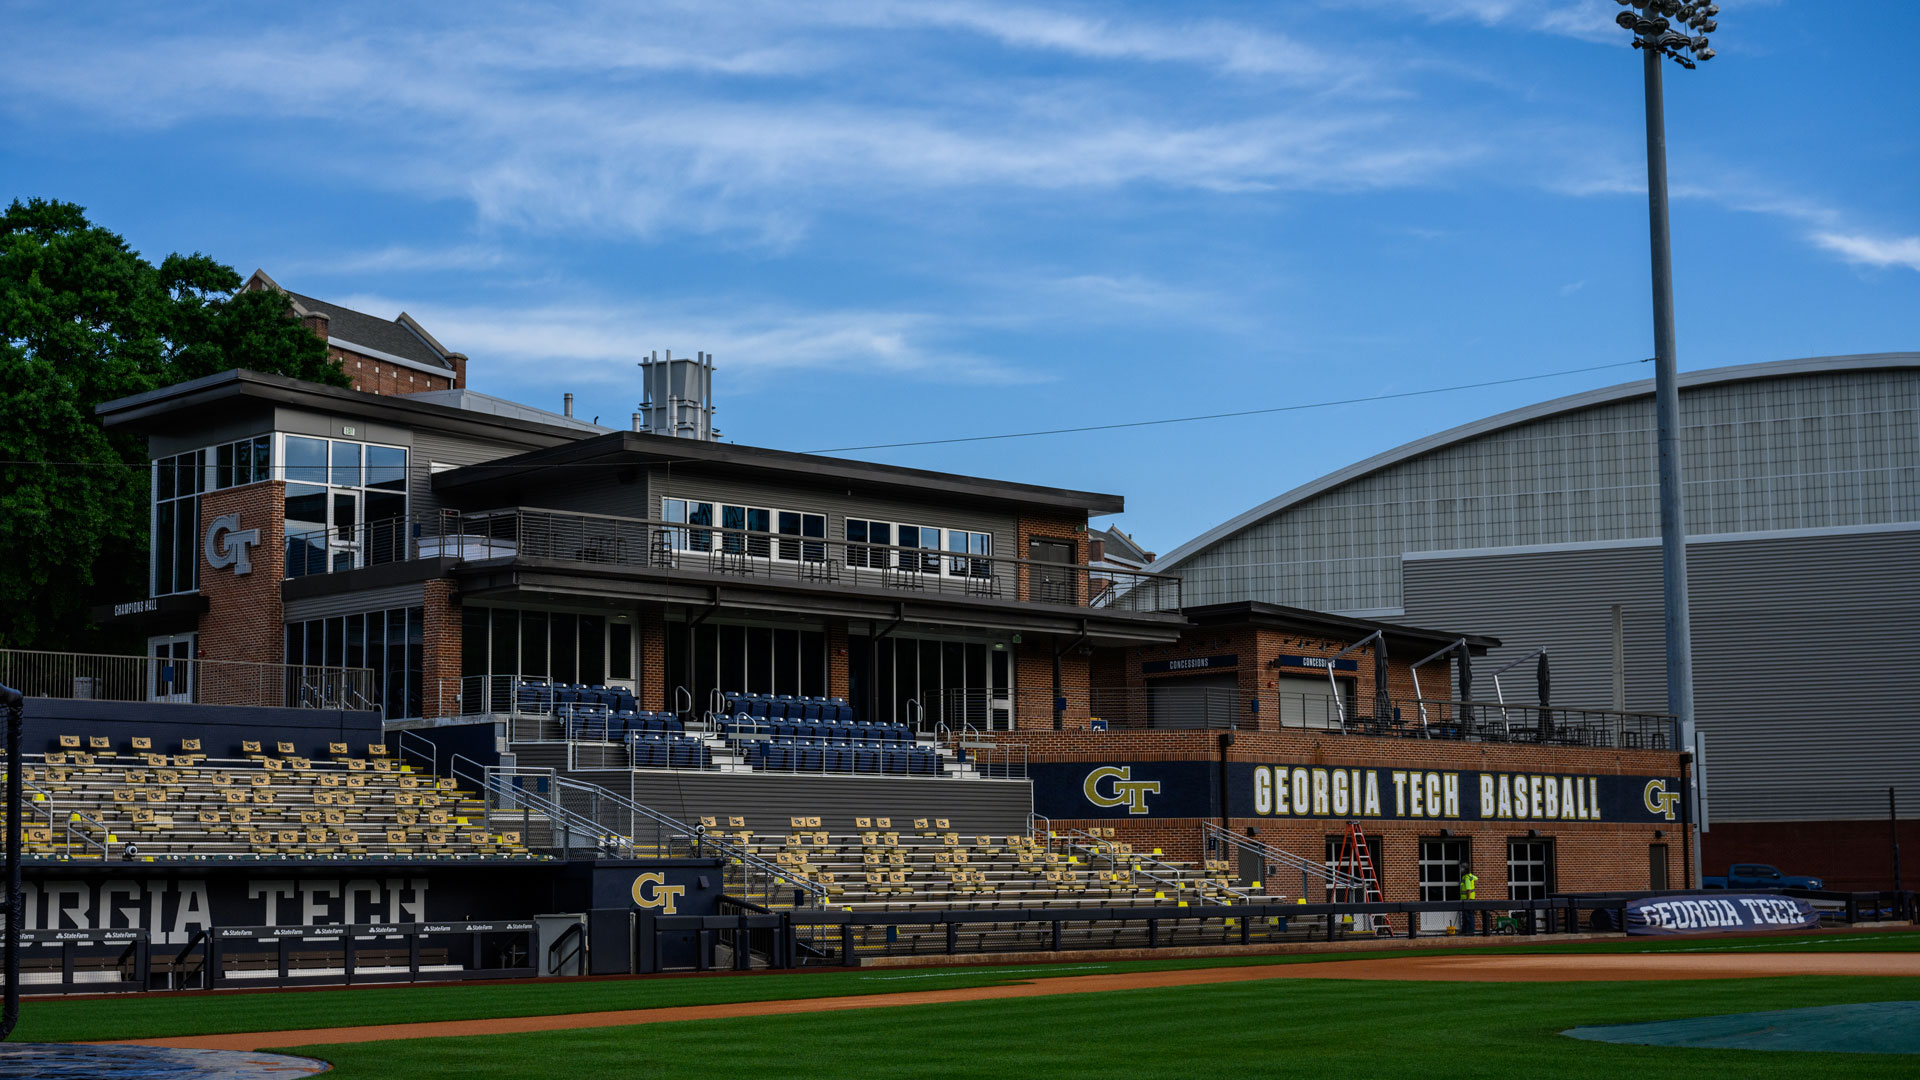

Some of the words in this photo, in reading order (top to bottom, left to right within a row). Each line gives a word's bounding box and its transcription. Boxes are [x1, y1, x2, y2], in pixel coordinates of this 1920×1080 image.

[204, 513, 260, 576] GT
[114, 600, 144, 616] CHAMPIONS
[145, 599, 157, 612] HALL
[1169, 657, 1208, 670] CONCESSIONS
[1302, 657, 1335, 669] CONCESSIS
[1082, 766, 1160, 815] GT
[1253, 766, 1381, 817] GEORGIA
[1392, 770, 1460, 818] TECH
[1479, 774, 1601, 821] BASEBALL
[1643, 779, 1680, 821] GT
[248, 879, 428, 942] TECH
[632, 872, 685, 914] GT
[1640, 900, 1744, 928] GEORGIA
[1739, 899, 1806, 924] TECH
